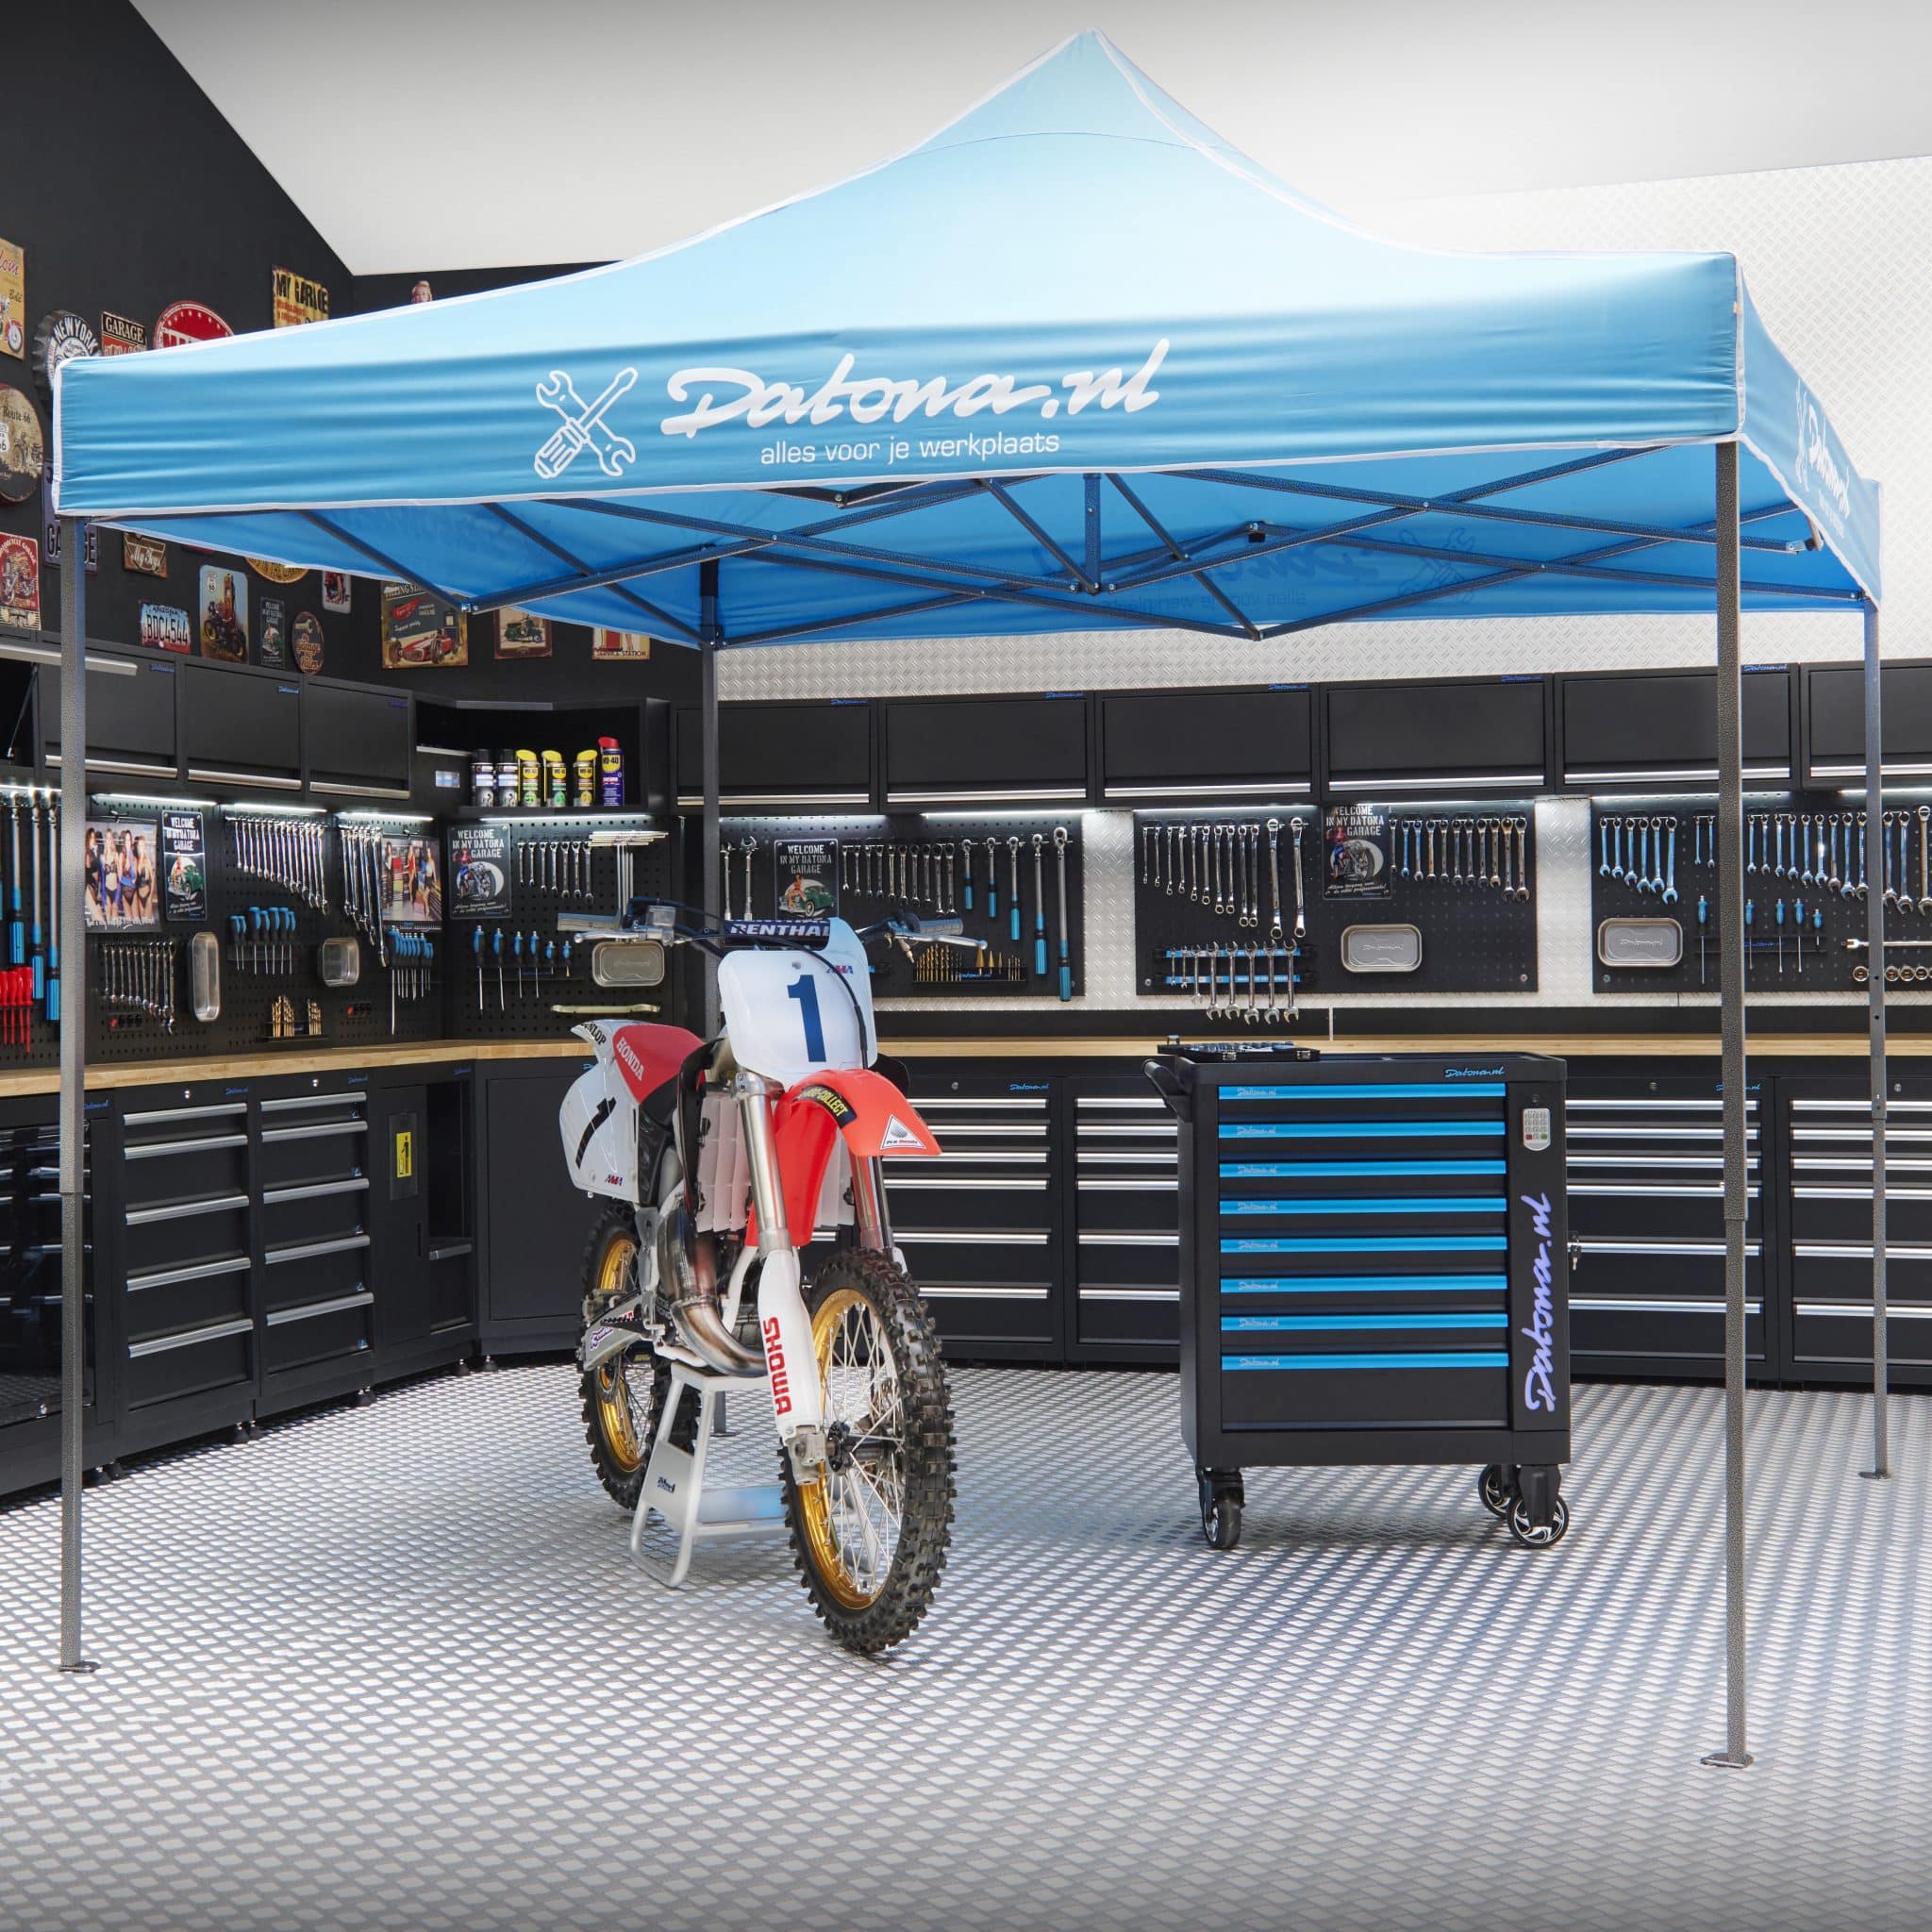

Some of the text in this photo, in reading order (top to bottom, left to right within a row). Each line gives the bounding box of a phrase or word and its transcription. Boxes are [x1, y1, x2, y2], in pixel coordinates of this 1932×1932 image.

[53, 316, 98, 356] NEW YORK
[105, 315, 144, 343] GARAGE
[661, 338, 1171, 439] Datona.nl
[760, 433, 1060, 465] alles voor je werkplaats
[145, 613, 188, 642] BDC4544
[622, 649, 647, 658] STATION
[1350, 815, 1385, 826] DATONA
[458, 829, 495, 840] WELCOME
[1346, 825, 1382, 837] GARAGE
[471, 848, 503, 858] GARAGE
[474, 838, 505, 848] DATONA
[787, 844, 825, 855] WELCOME
[791, 863, 823, 875] GARAGE
[801, 854, 832, 864] DATONA
[787, 974, 826, 1062] 1
[616, 1036, 645, 1082] HONDA
[1445, 1066, 1505, 1078] Datona.nl
[575, 1096, 617, 1170] 1
[1521, 1192, 1557, 1413] Datona.nl
[762, 1316, 793, 1417] SHOWA
